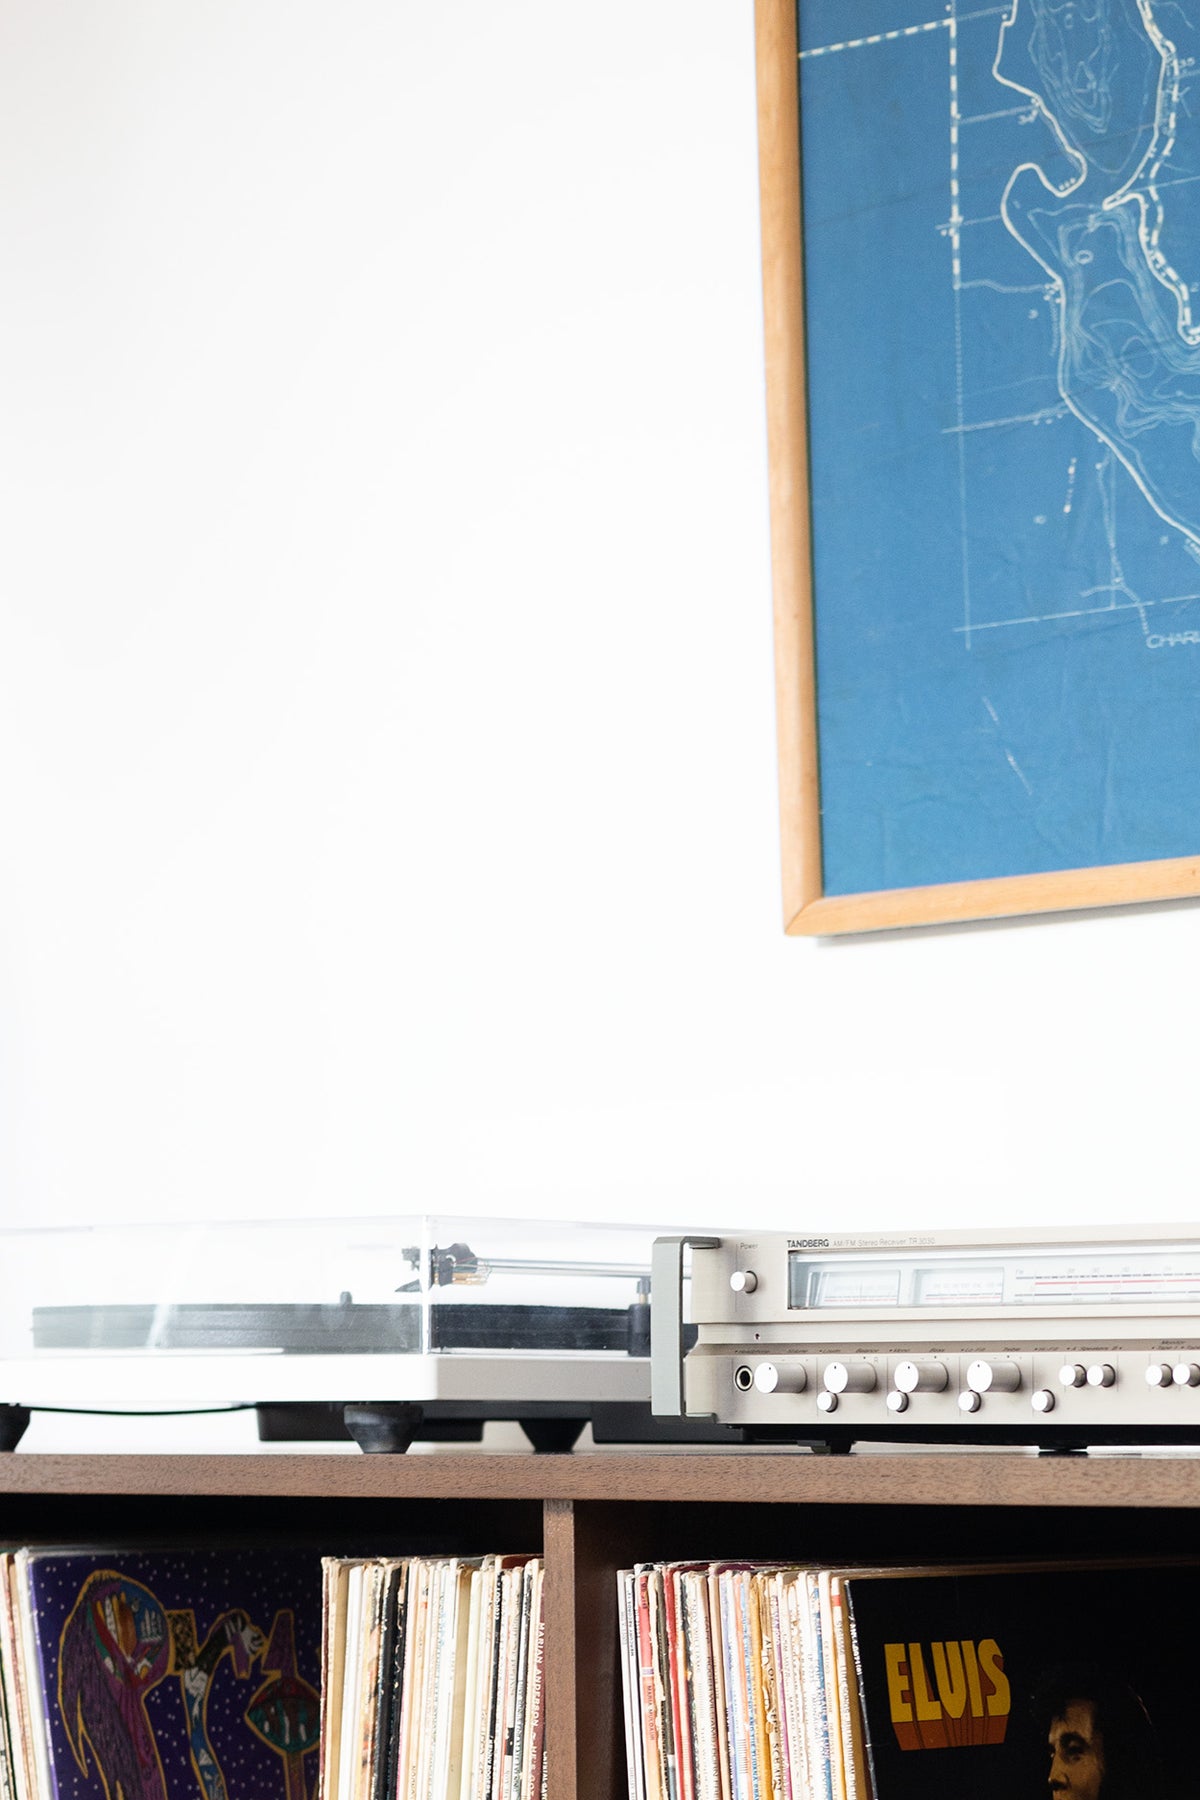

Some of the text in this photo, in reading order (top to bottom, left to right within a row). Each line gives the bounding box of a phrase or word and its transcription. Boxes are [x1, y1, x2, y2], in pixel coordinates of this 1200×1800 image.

[740, 1242, 759, 1251] Power
[787, 1237, 906, 1249] TANDBERG Stereo Receiver
[531, 1622, 545, 1726] MARIAN ANDERSON
[884, 1639, 1011, 1732] ELVIS
